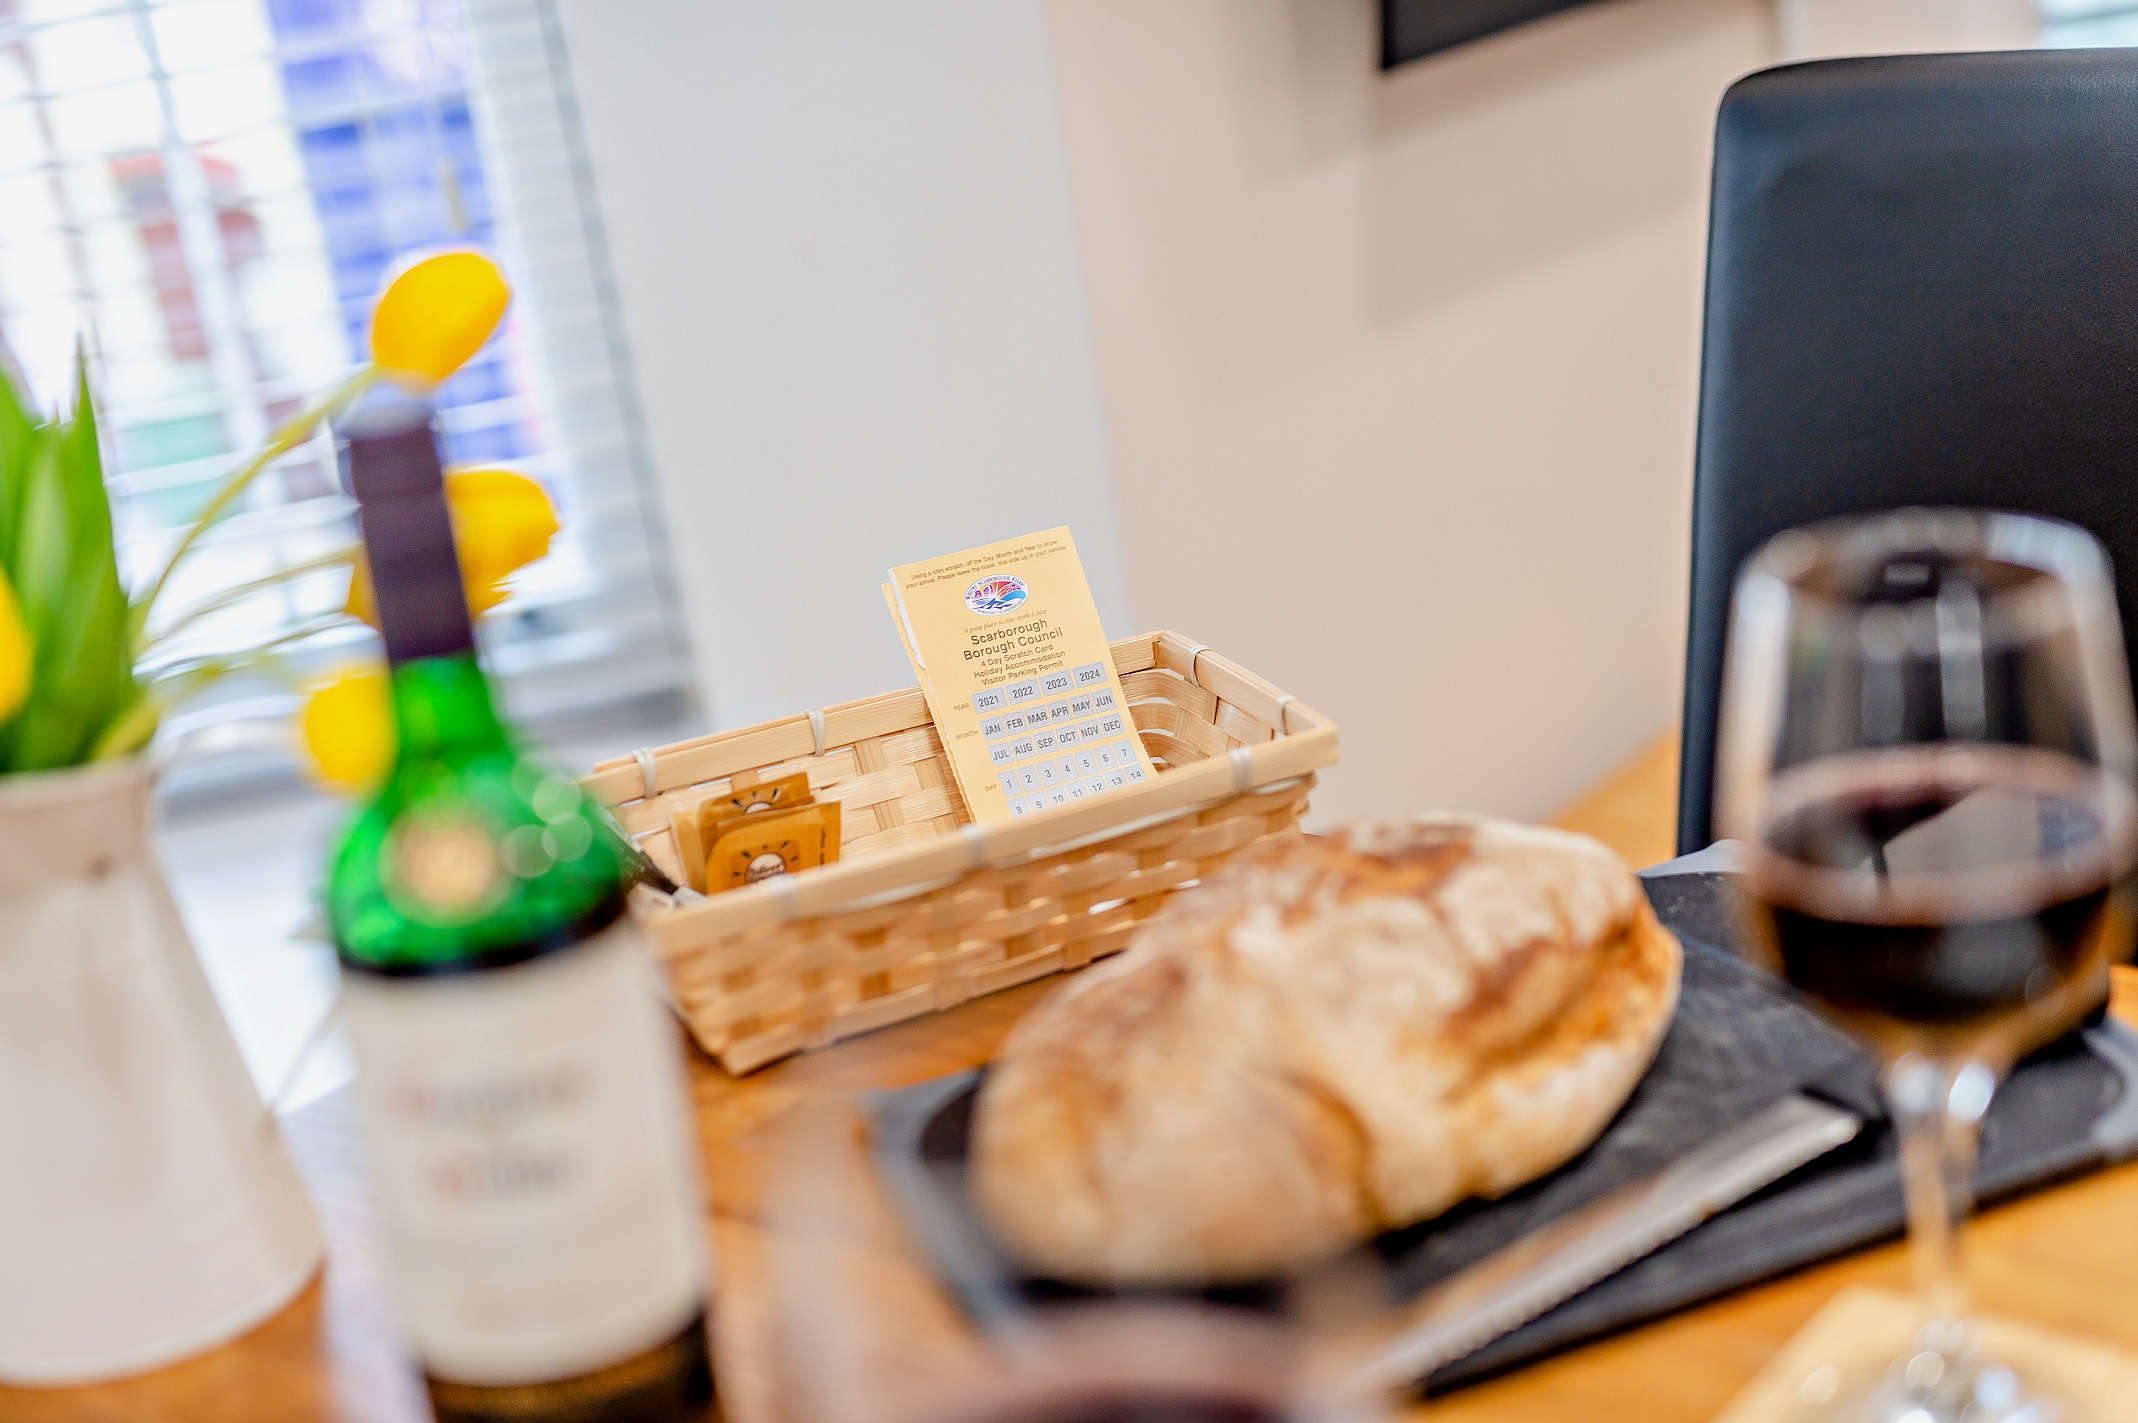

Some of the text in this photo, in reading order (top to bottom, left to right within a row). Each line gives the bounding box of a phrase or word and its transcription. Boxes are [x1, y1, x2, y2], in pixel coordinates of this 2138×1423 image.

[964, 627, 1063, 660] Borough Council
[970, 619, 1048, 645] Scarborough
[974, 650, 1066, 678] Holiday Accommodation
[981, 660, 1064, 686] Visitor Parking Permit
[987, 657, 1002, 666] Day
[1004, 648, 1034, 661] Scratch
[1034, 644, 1054, 654] Card
[953, 669, 1101, 711] YEAR 2021 2022 2023 2024
[956, 695, 1112, 740] MONTH JAN FEB MAR APR MAY JUN
[993, 720, 1121, 762] JUL AUG SEP OCT NOV DEC
[985, 748, 1128, 792] DAY 1 2 3 4 5 6 7
[1016, 770, 1142, 815] 8 9 10 11 12 13 14
